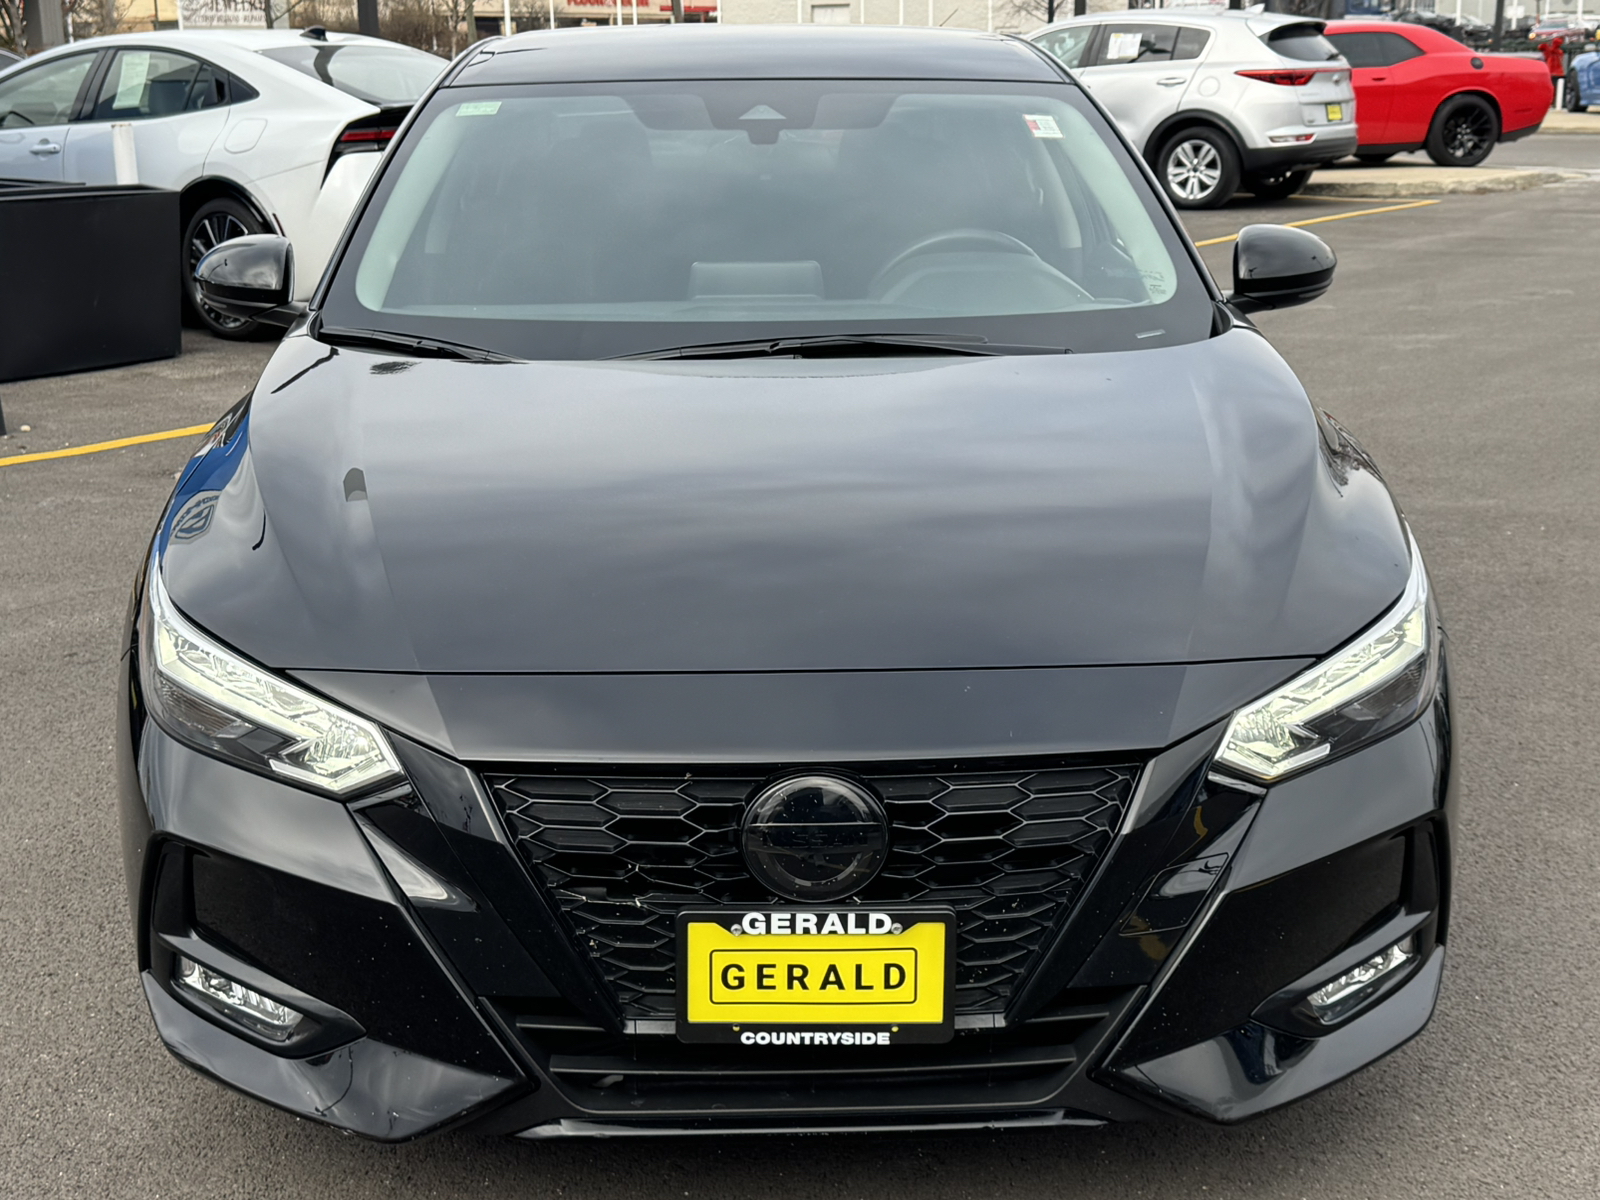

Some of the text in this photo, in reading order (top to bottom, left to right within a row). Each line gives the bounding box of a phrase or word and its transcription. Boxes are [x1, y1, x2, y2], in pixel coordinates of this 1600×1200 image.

[742, 911, 893, 935] GERALD
[721, 963, 907, 991] GERALD
[740, 1032, 891, 1046] COUNTRYSIDE
